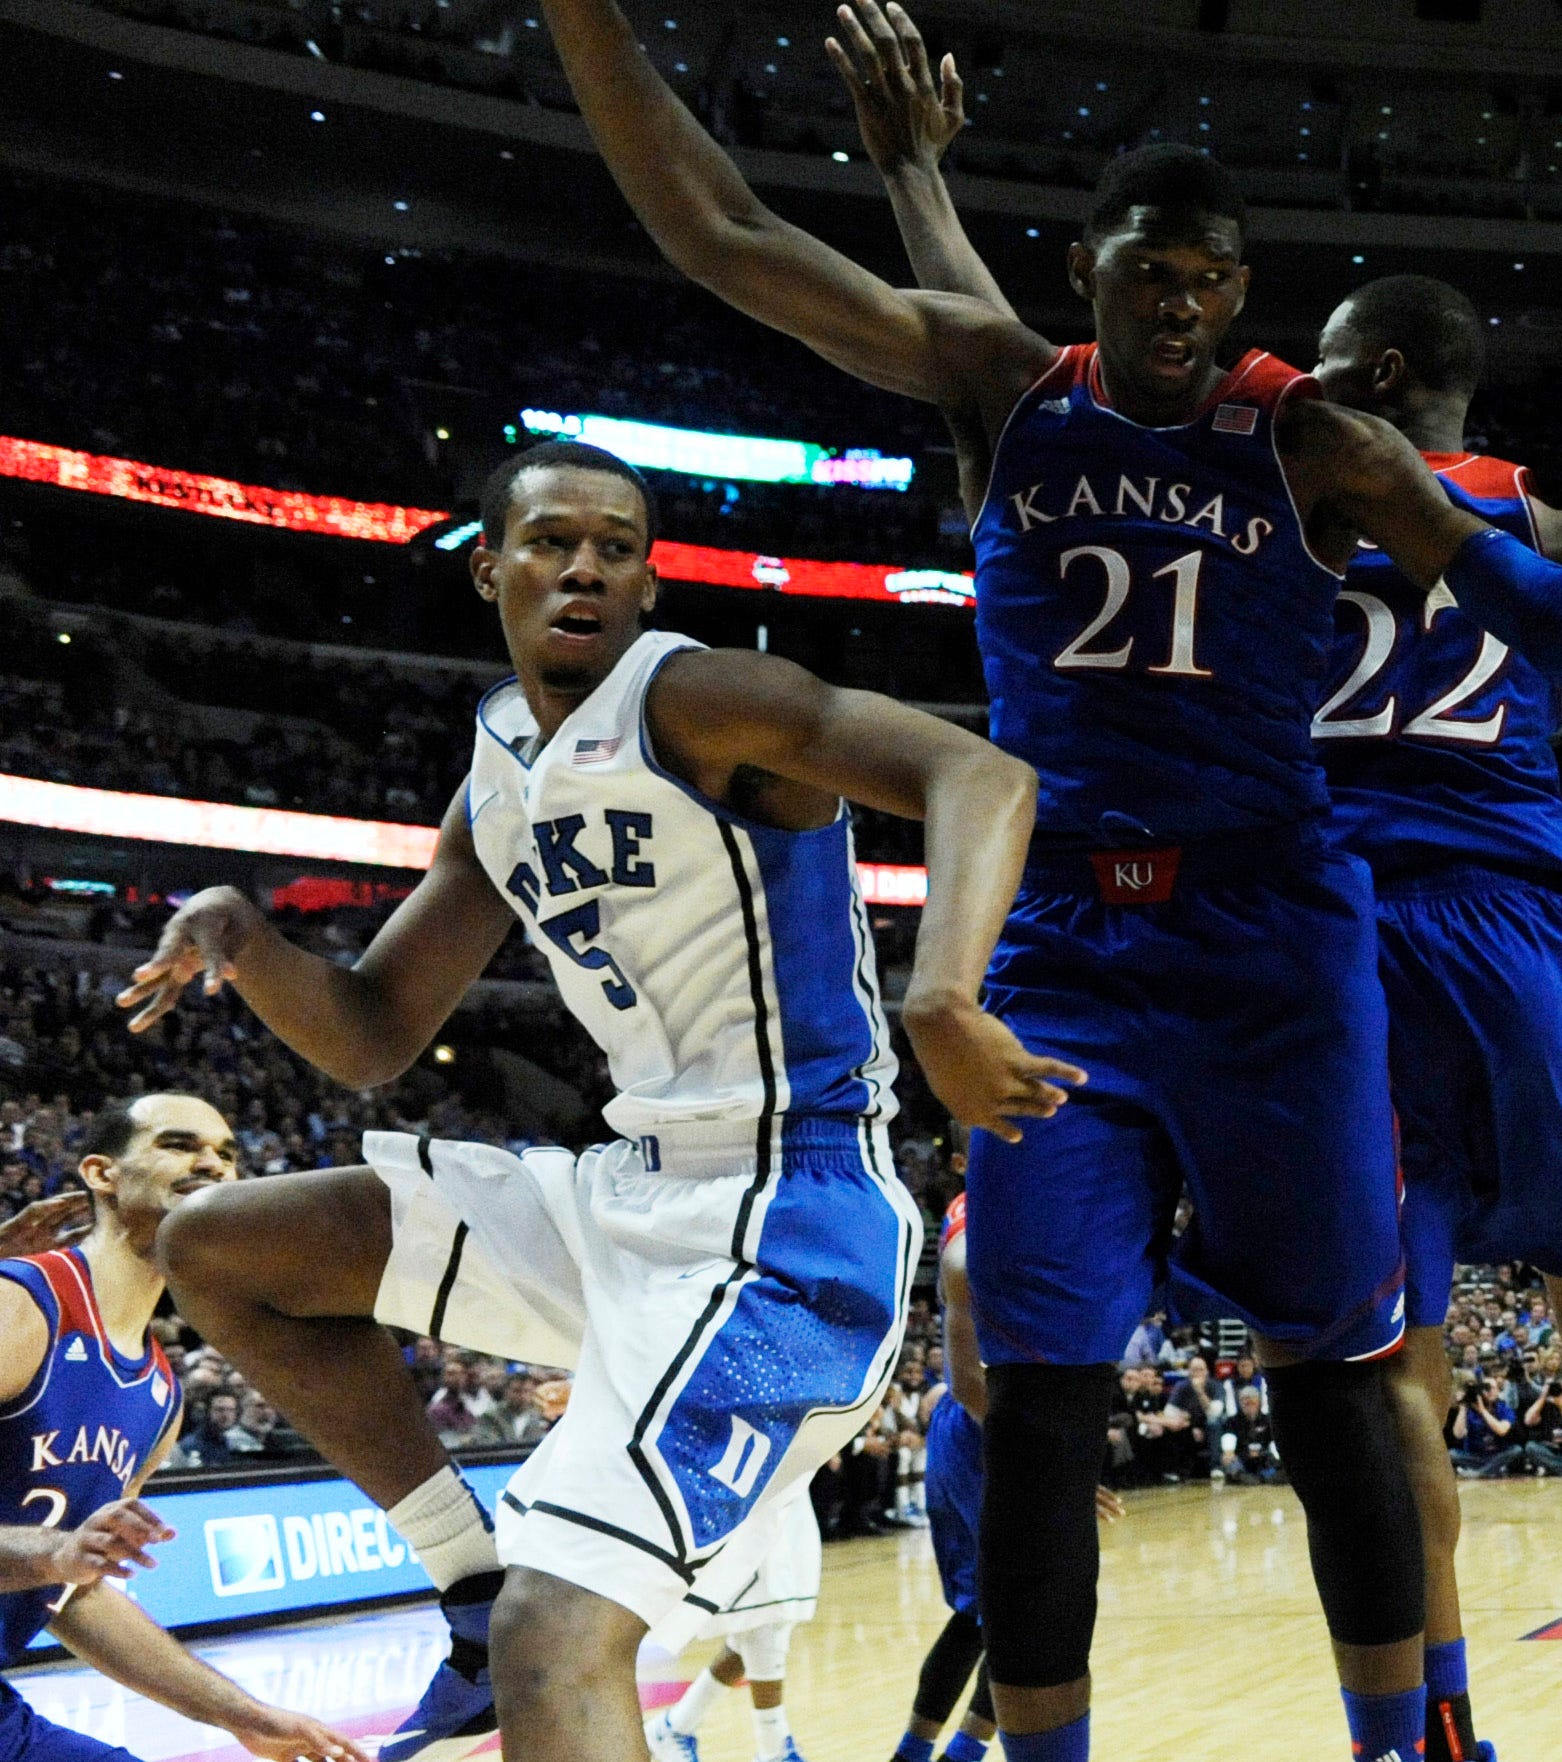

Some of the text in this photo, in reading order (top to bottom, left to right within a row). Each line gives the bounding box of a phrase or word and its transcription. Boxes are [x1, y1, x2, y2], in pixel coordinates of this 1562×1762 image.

[1009, 474, 1273, 555] KANSAS
[1053, 545, 1212, 676] 21
[1310, 574, 1509, 743] 22
[506, 809, 656, 920] DKE
[1115, 862, 1153, 890] KU
[540, 898, 637, 1011] 5
[283, 1508, 421, 1581] DIREC
